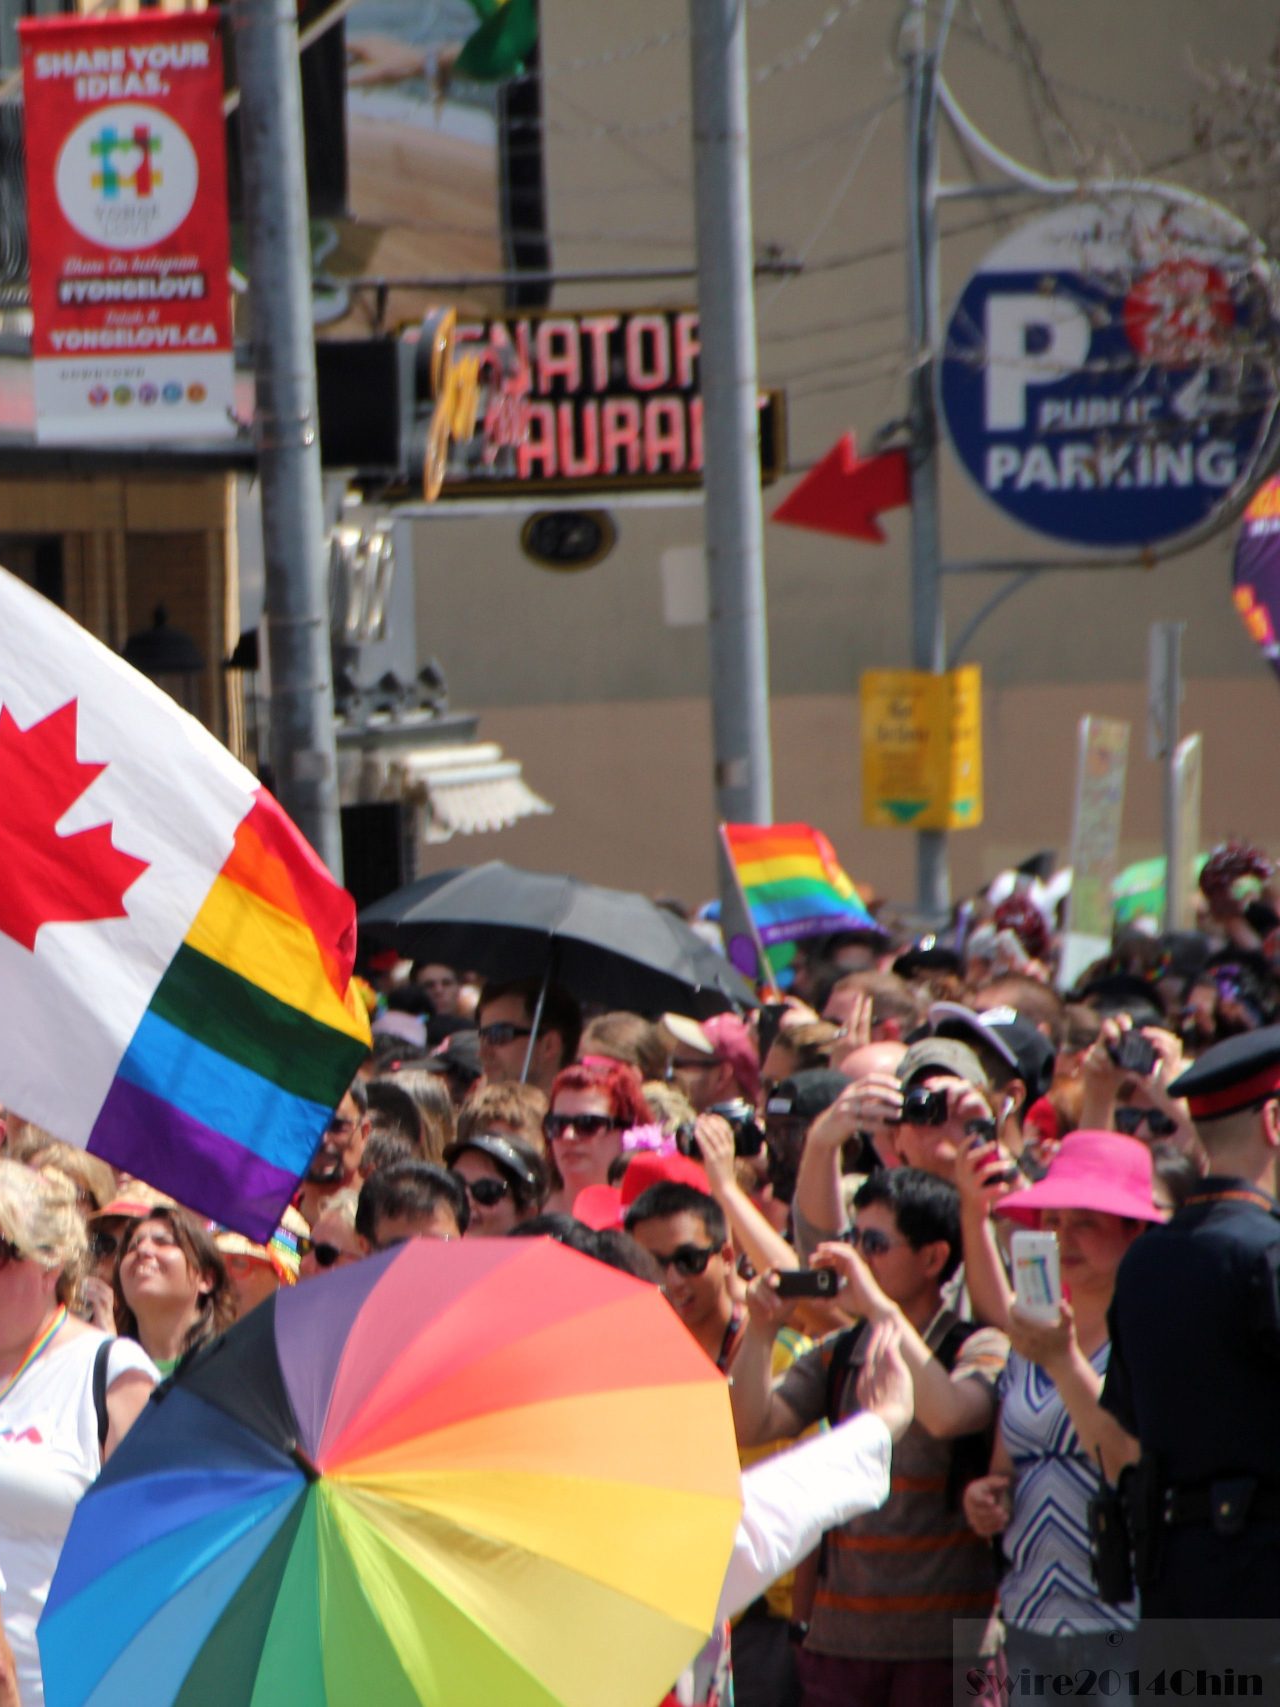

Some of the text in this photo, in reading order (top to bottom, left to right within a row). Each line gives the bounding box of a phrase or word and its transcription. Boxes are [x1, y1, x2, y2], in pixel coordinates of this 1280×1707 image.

[35, 42, 210, 79] SHARE YOUR
[50, 325, 218, 351] YONGELOVE.CA
[985, 294, 1091, 431] P
[986, 443, 1237, 491] PARKING
